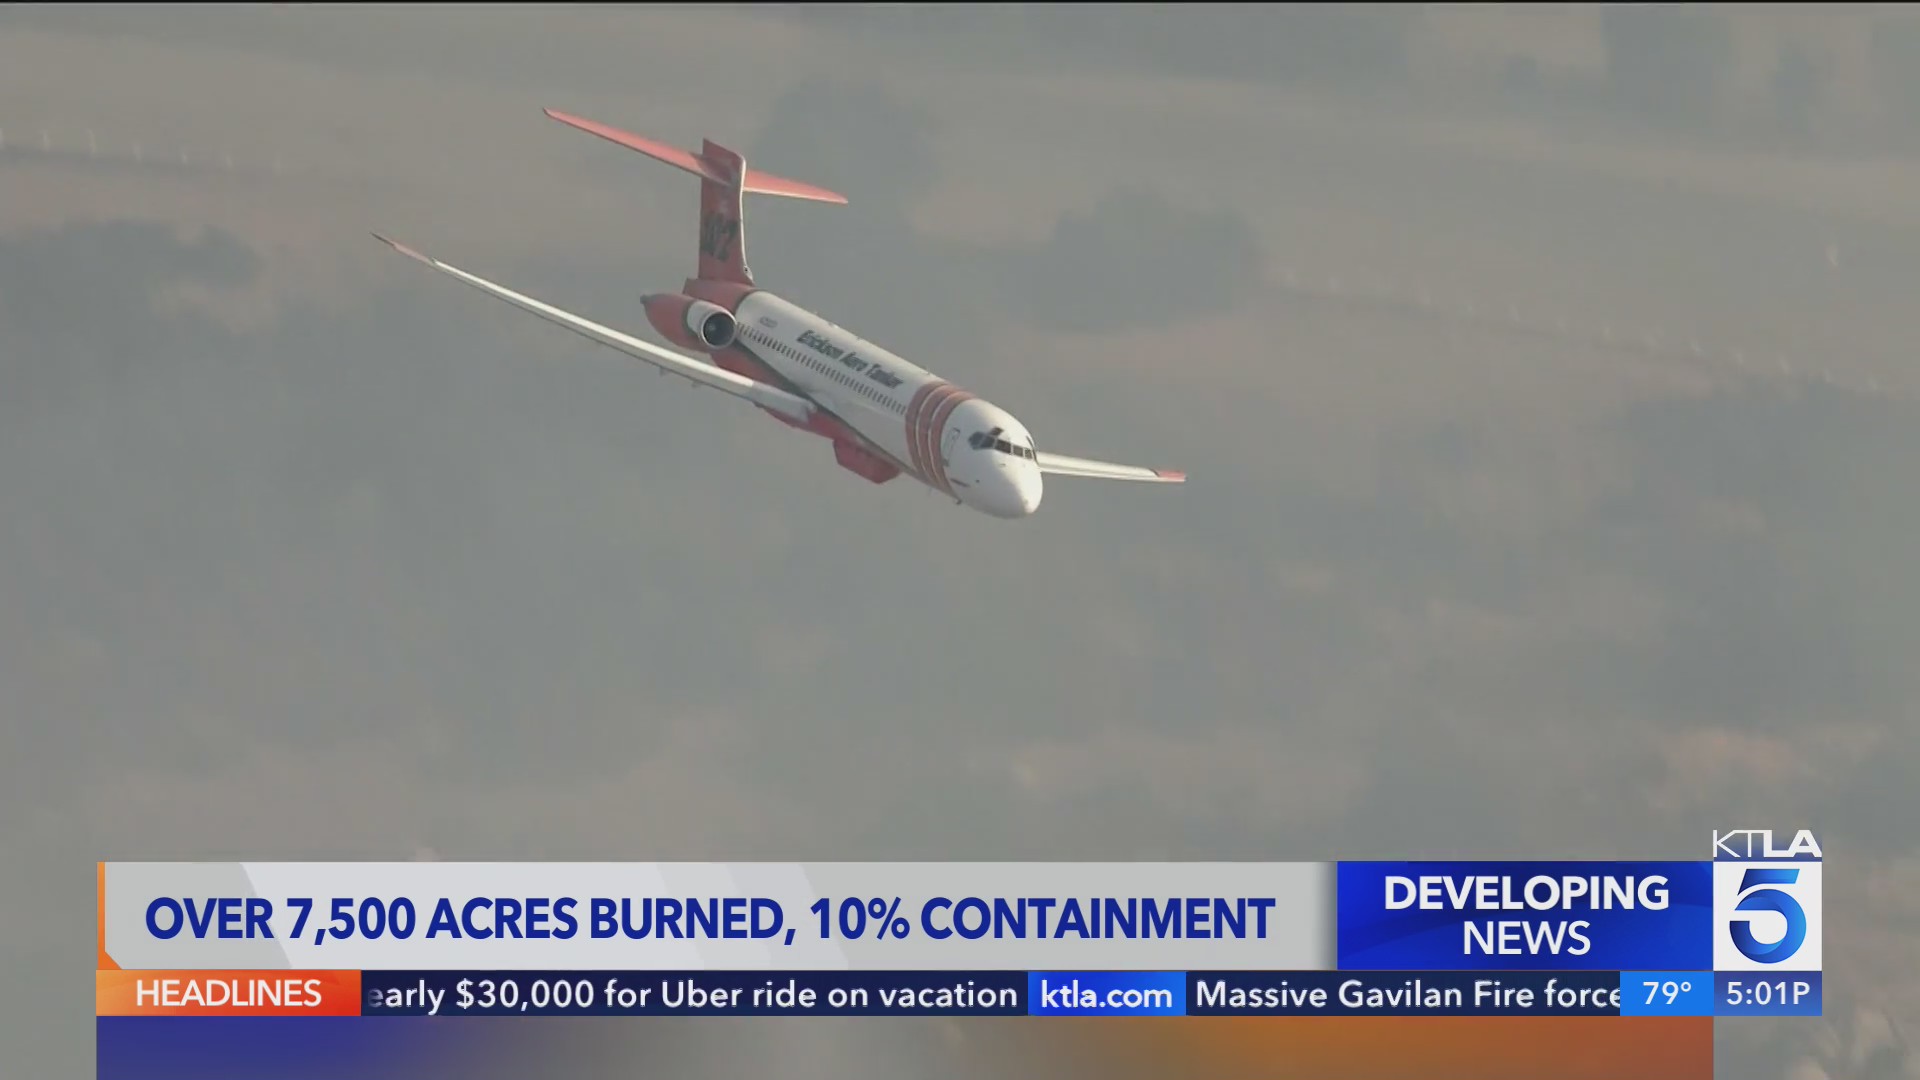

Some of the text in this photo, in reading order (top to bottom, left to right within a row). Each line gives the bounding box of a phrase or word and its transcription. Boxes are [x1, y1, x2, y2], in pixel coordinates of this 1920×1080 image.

[797, 329, 904, 389] Erickson Aero Tanker
